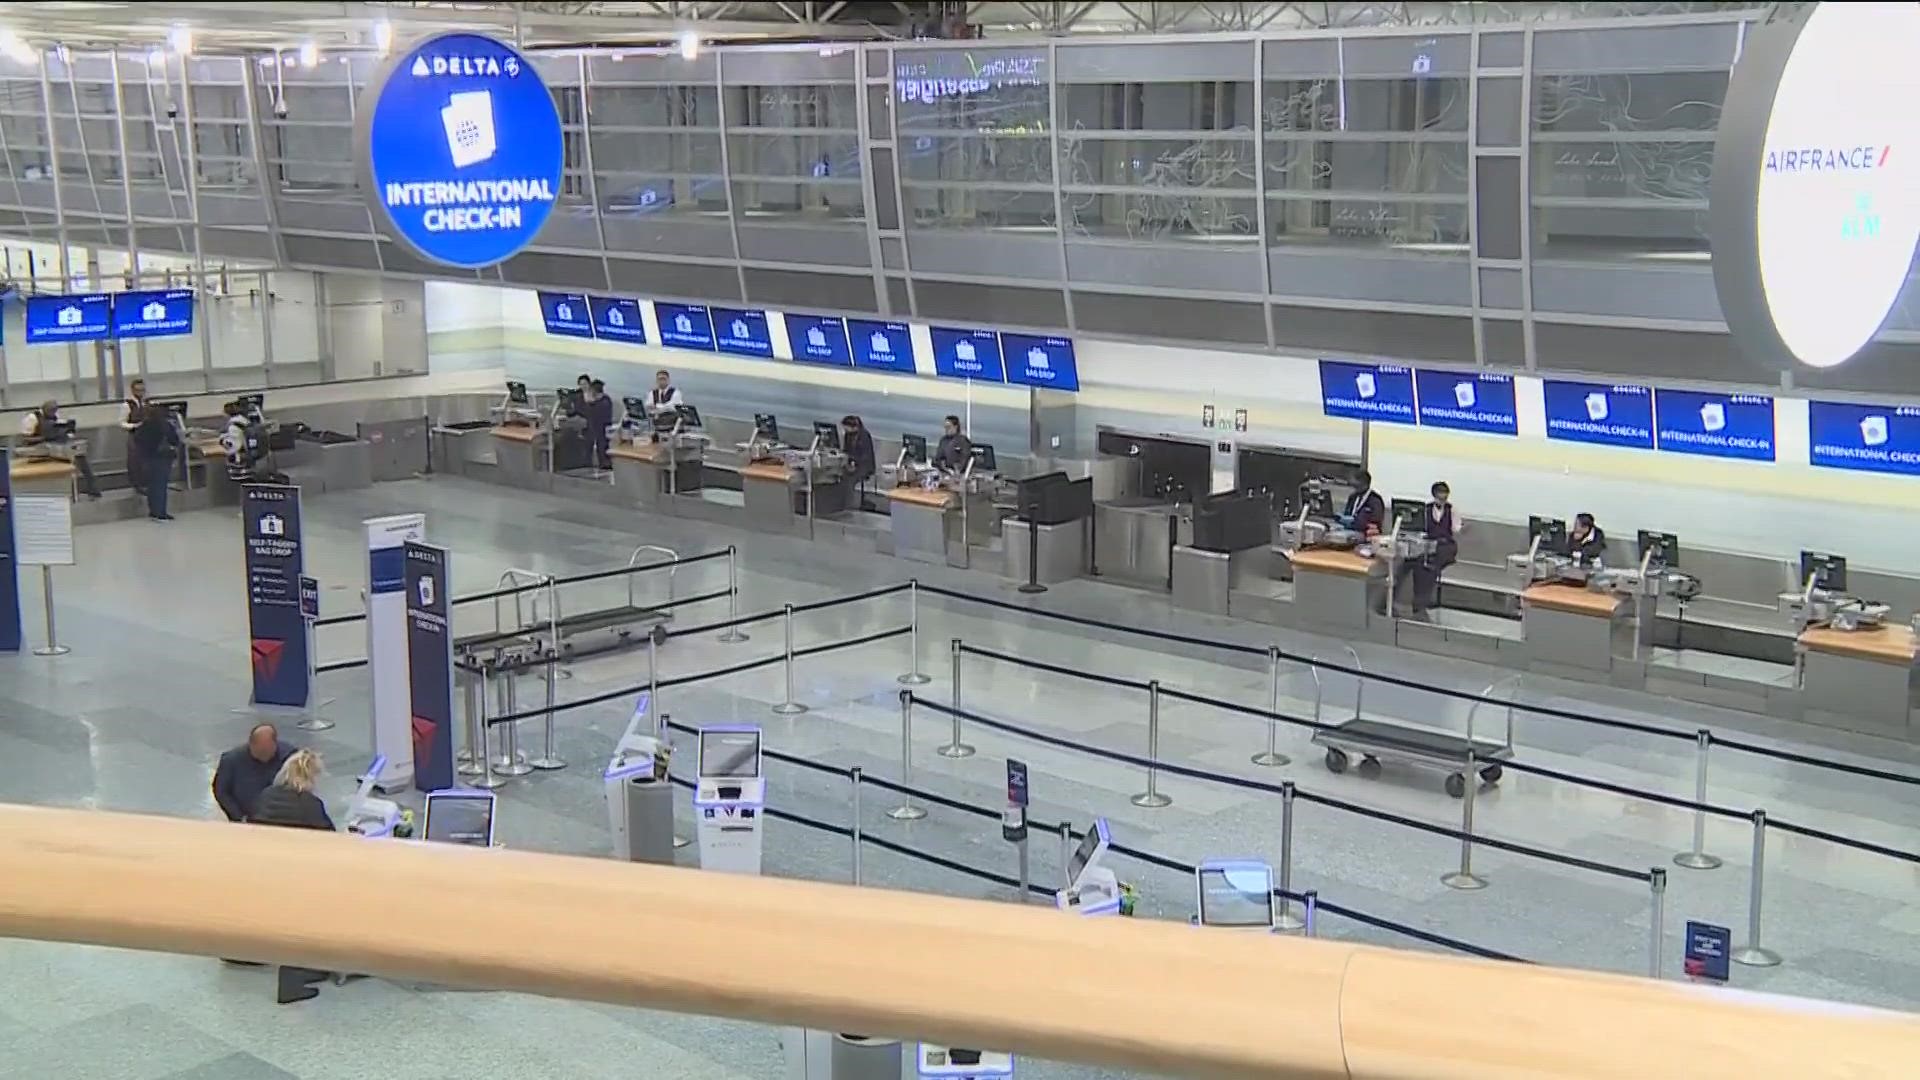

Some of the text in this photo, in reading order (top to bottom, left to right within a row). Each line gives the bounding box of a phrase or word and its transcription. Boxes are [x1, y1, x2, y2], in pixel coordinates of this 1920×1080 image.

[433, 56, 500, 76] DELTA
[386, 178, 554, 206] INTERNATIONAL
[423, 205, 521, 232] CHECK-IN
[1550, 418, 1649, 439] INTERNATIONAL CHECK-IN
[1661, 430, 1770, 450] INTERNATIONAL CHECK-IN
[1814, 444, 1889, 461] INTERNATIONAL
